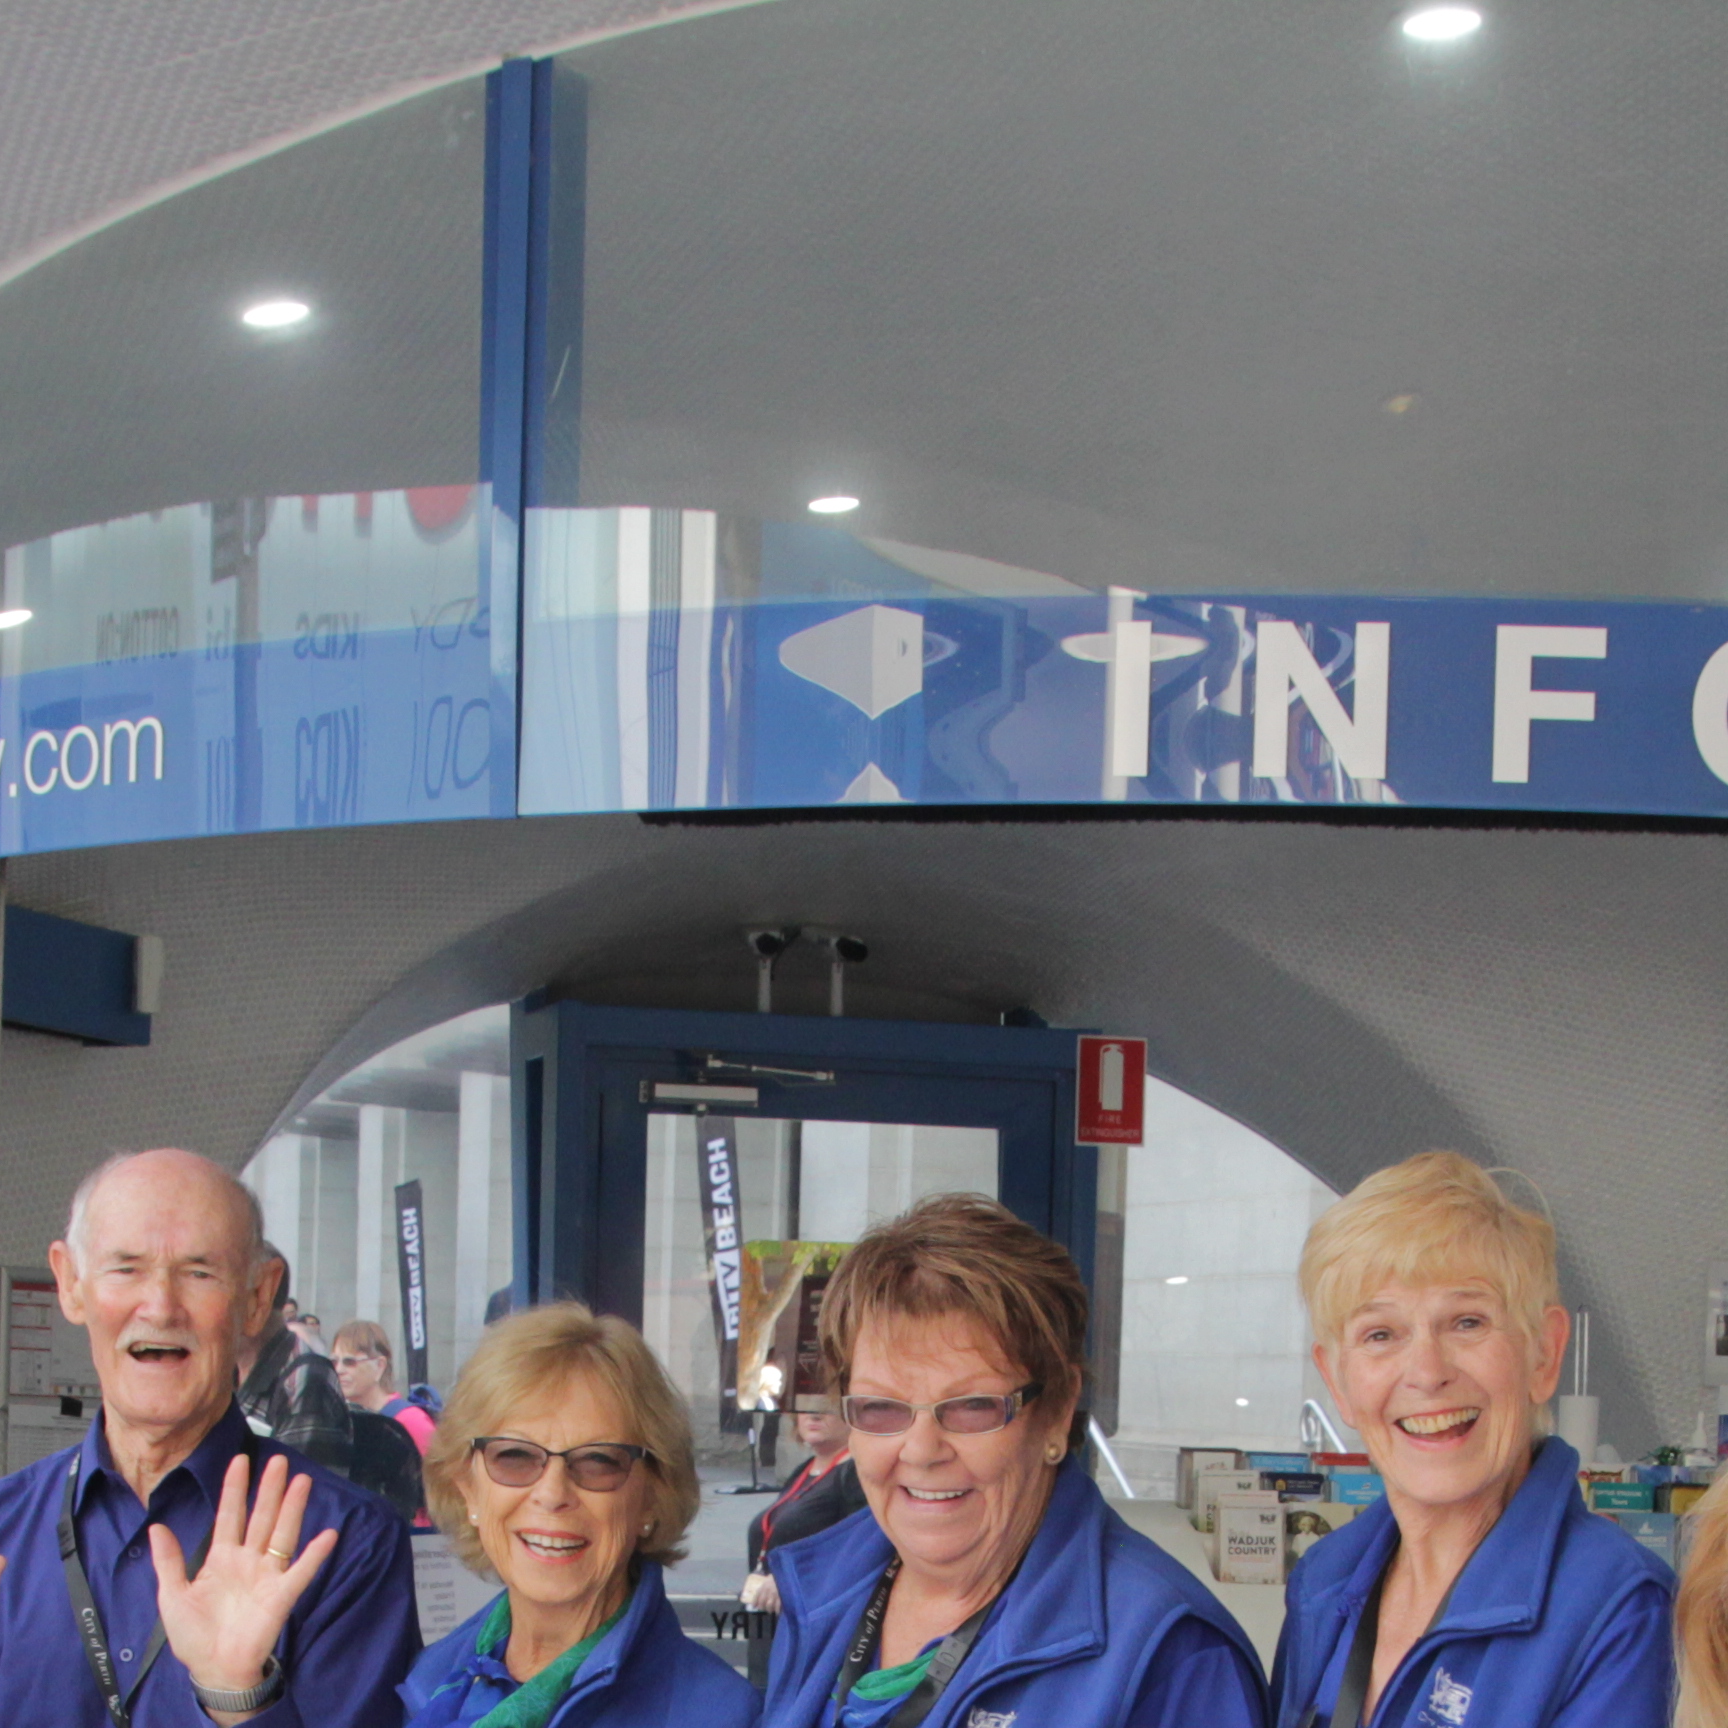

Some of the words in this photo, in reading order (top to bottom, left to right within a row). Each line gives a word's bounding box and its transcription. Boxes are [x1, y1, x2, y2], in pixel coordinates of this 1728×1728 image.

[706, 1137, 738, 1250] BEACH
[402, 1207, 422, 1286] BEACH
[1227, 1546, 1277, 1556] COUNTRY
[1228, 1535, 1276, 1546] WADJUK
[82, 1607, 97, 1634] CITY
[849, 1635, 870, 1663] CITY
